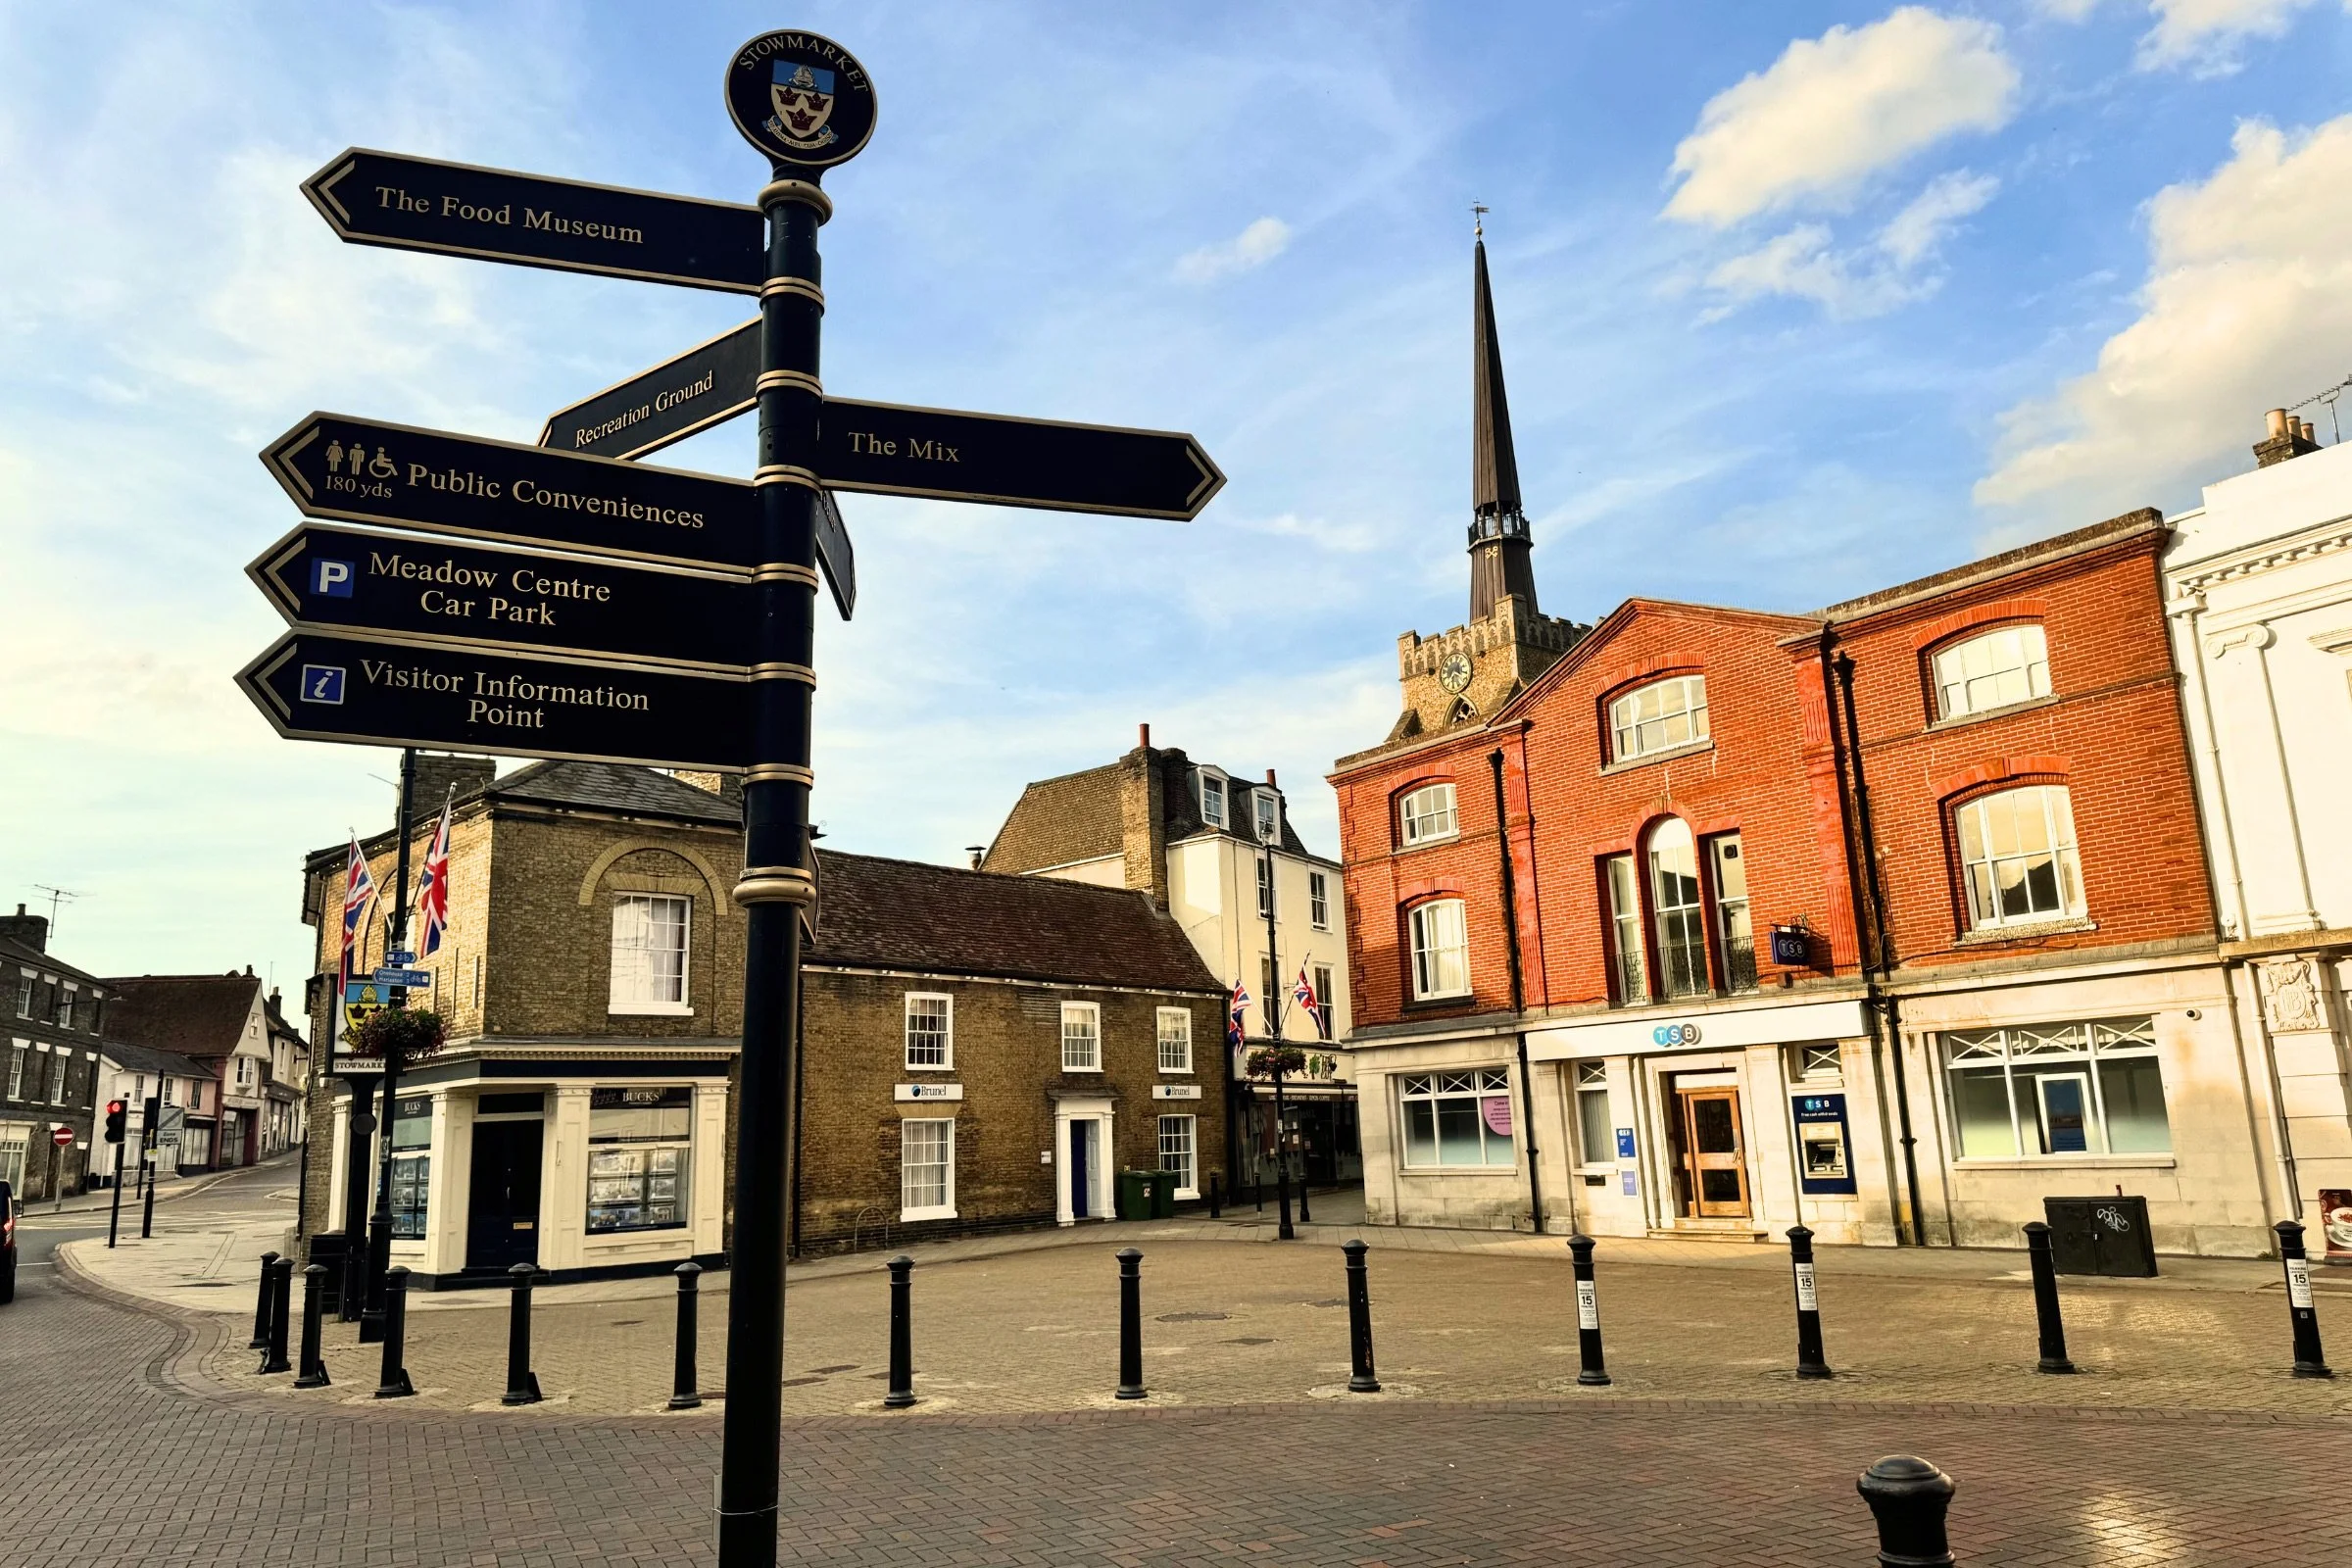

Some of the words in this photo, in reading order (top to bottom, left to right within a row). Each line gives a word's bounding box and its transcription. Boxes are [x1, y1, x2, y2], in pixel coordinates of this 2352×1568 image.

[739, 35, 869, 92] STOWMARKET
[375, 186, 429, 213] The
[441, 196, 511, 225] Food
[523, 207, 644, 244] Museum
[574, 405, 650, 449] Recreation
[655, 369, 713, 412] Ground
[848, 432, 898, 457] The
[907, 438, 960, 464] Mix
[325, 475, 356, 493] 180
[360, 484, 392, 499] yds
[407, 463, 501, 499] Public
[512, 480, 705, 529] Conveniences
[318, 561, 349, 593] P
[368, 551, 499, 588] Meadow
[512, 569, 612, 603] Centre
[420, 589, 476, 617] Car
[487, 596, 558, 627] Park
[361, 659, 466, 693] Visitor
[473, 670, 650, 711] Information
[466, 698, 545, 728] Point
[1655, 1026, 1694, 1043] TSB
[622, 1093, 660, 1102] BUCKS
[921, 1085, 947, 1097] Brunel
[1171, 1087, 1190, 1096] Brunel
[1806, 1100, 1831, 1108] TSB
[1801, 1278, 1812, 1287] 15
[2294, 1274, 2306, 1283] 15
[1582, 1296, 1592, 1304] 15
